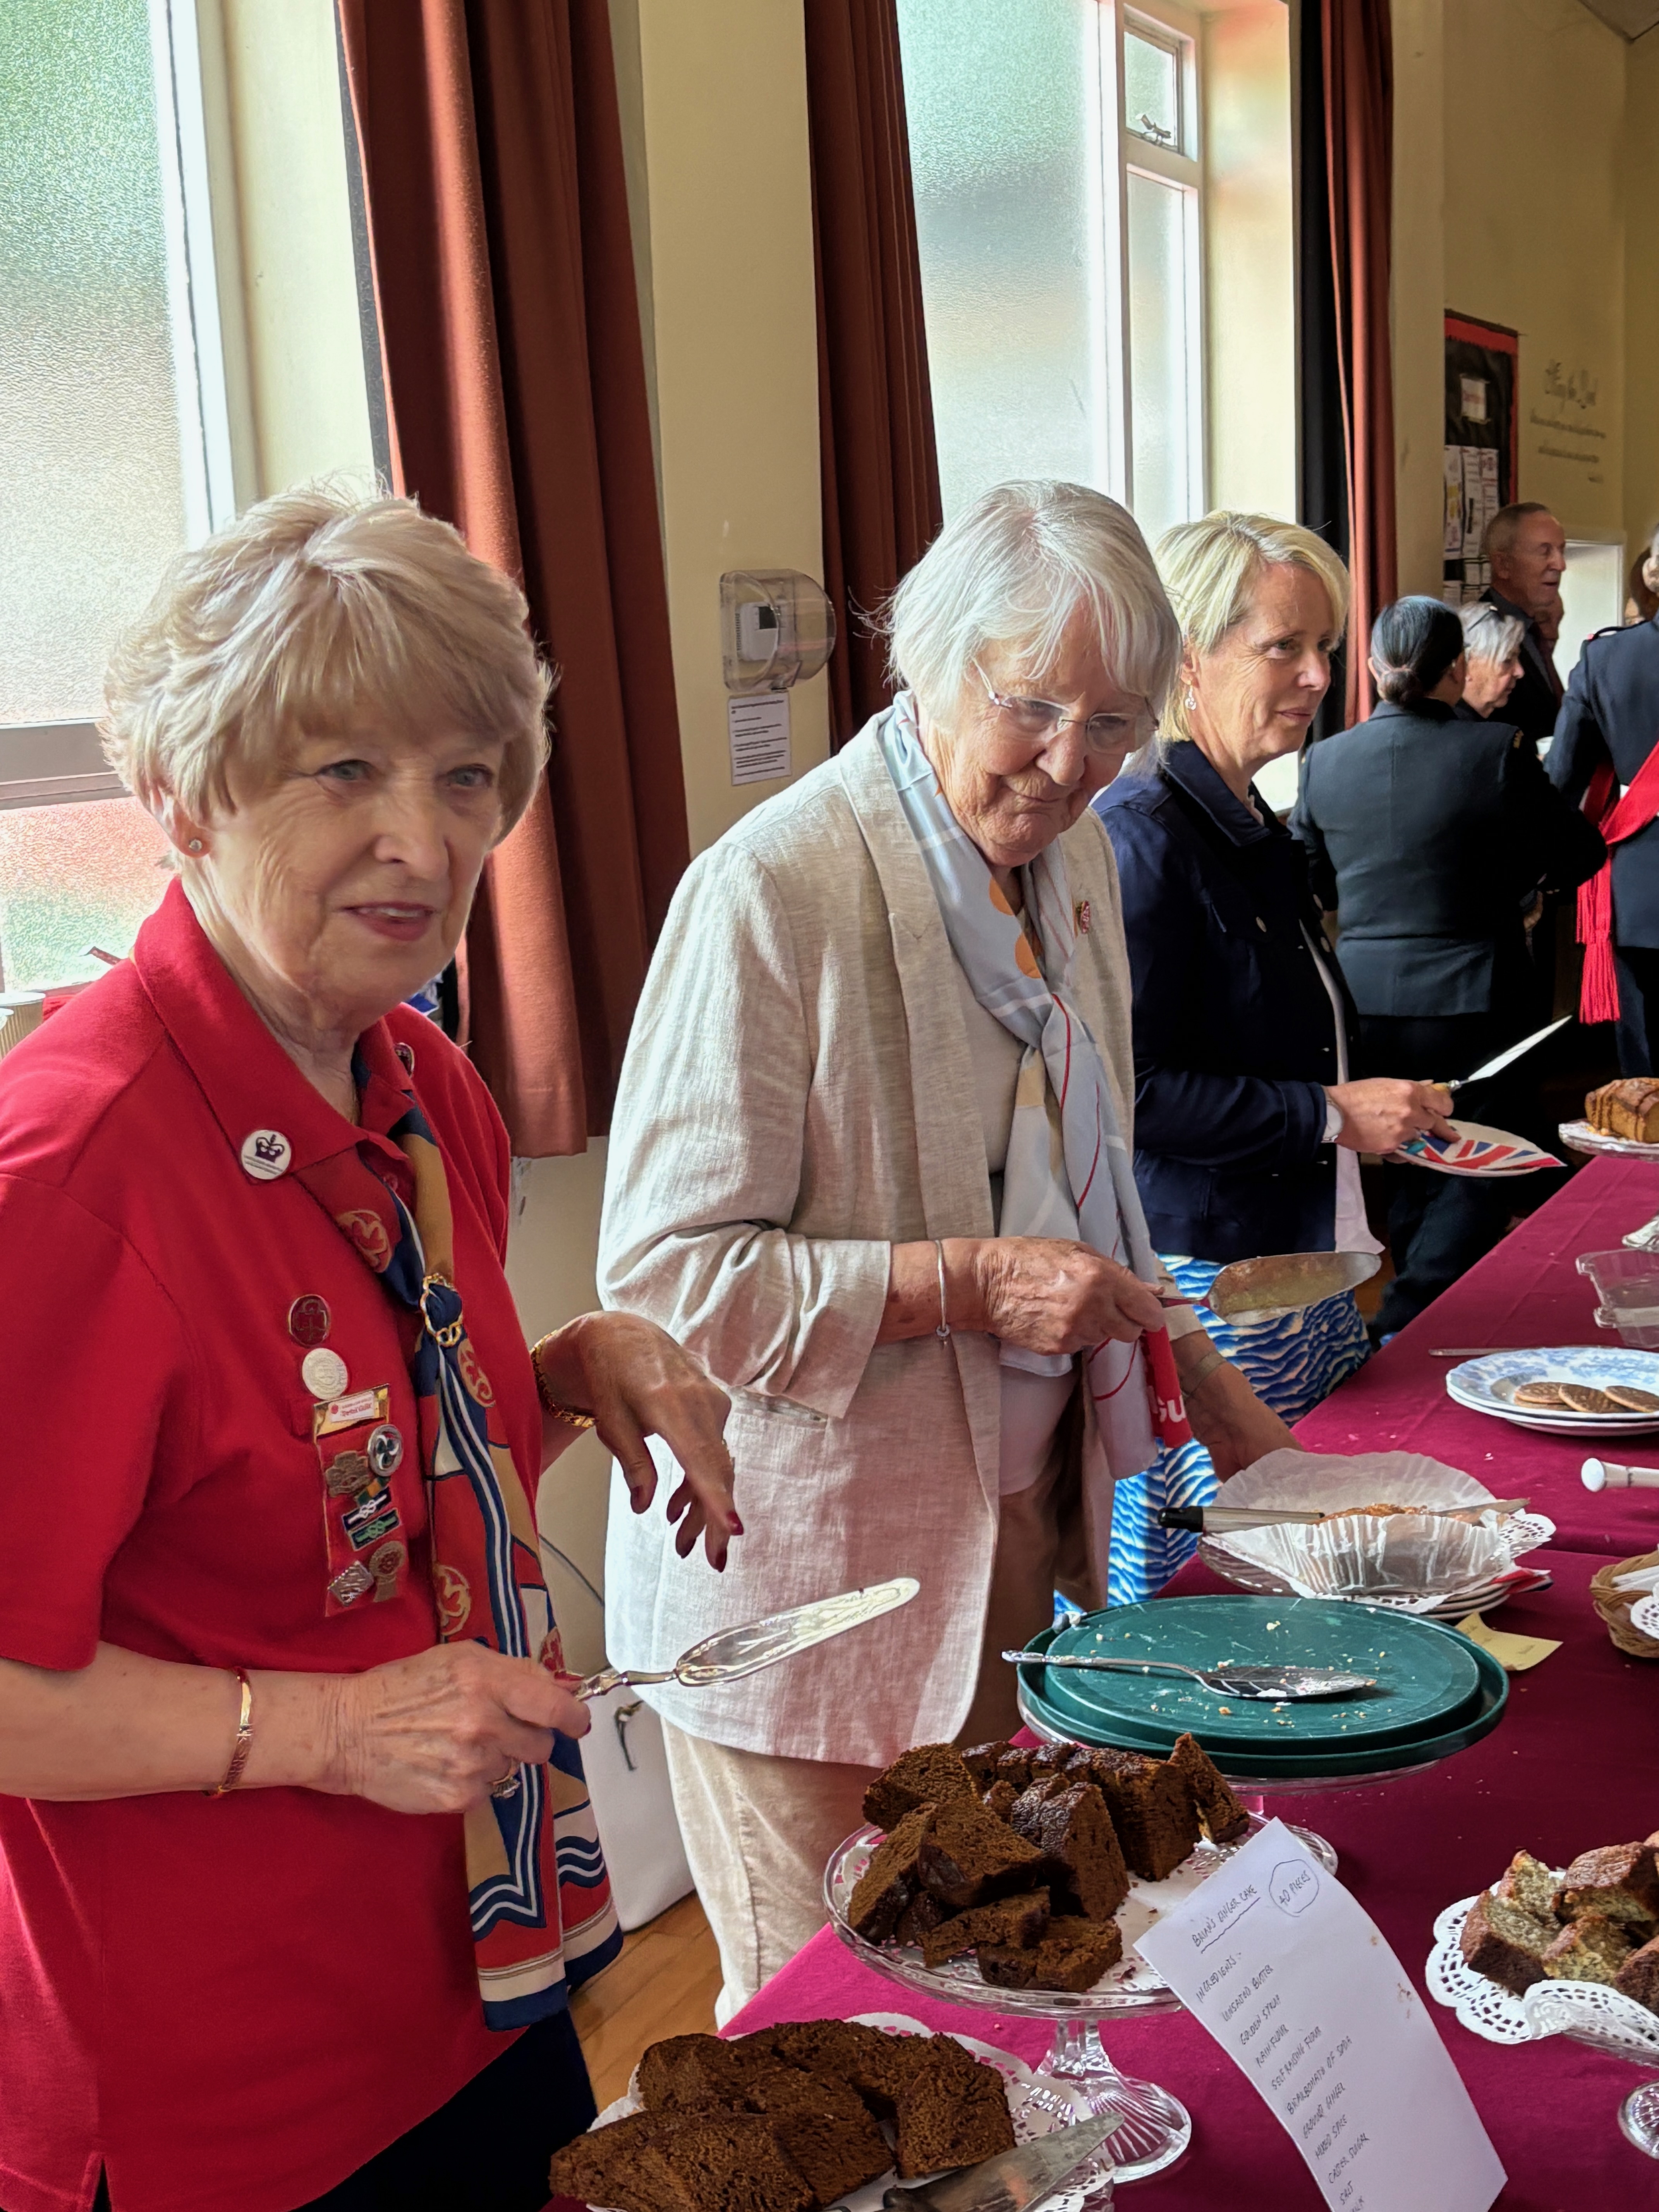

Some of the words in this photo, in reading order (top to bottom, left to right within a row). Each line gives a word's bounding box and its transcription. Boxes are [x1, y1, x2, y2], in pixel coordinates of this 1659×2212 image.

[1279, 1889, 1290, 1906] 40
[1289, 1870, 1310, 1894] PIECES
[1218, 1898, 1241, 1922] GINGER
[1239, 1885, 1257, 1901] CAKE
[1252, 1964, 1274, 1989] BUTTER
[1240, 2014, 1261, 2045] GOLDEN
[1270, 2024, 1289, 2048] FLOUR
[1272, 2068, 1287, 2090] SELF
[1304, 2026, 1321, 2049] FLOUR
[1327, 2051, 1335, 2068] OF
[1337, 2035, 1352, 2056] SODA
[1326, 2082, 1346, 2110] GINGER
[1349, 2133, 1369, 2159] SUGAR
[1340, 2181, 1353, 2205] SALT
